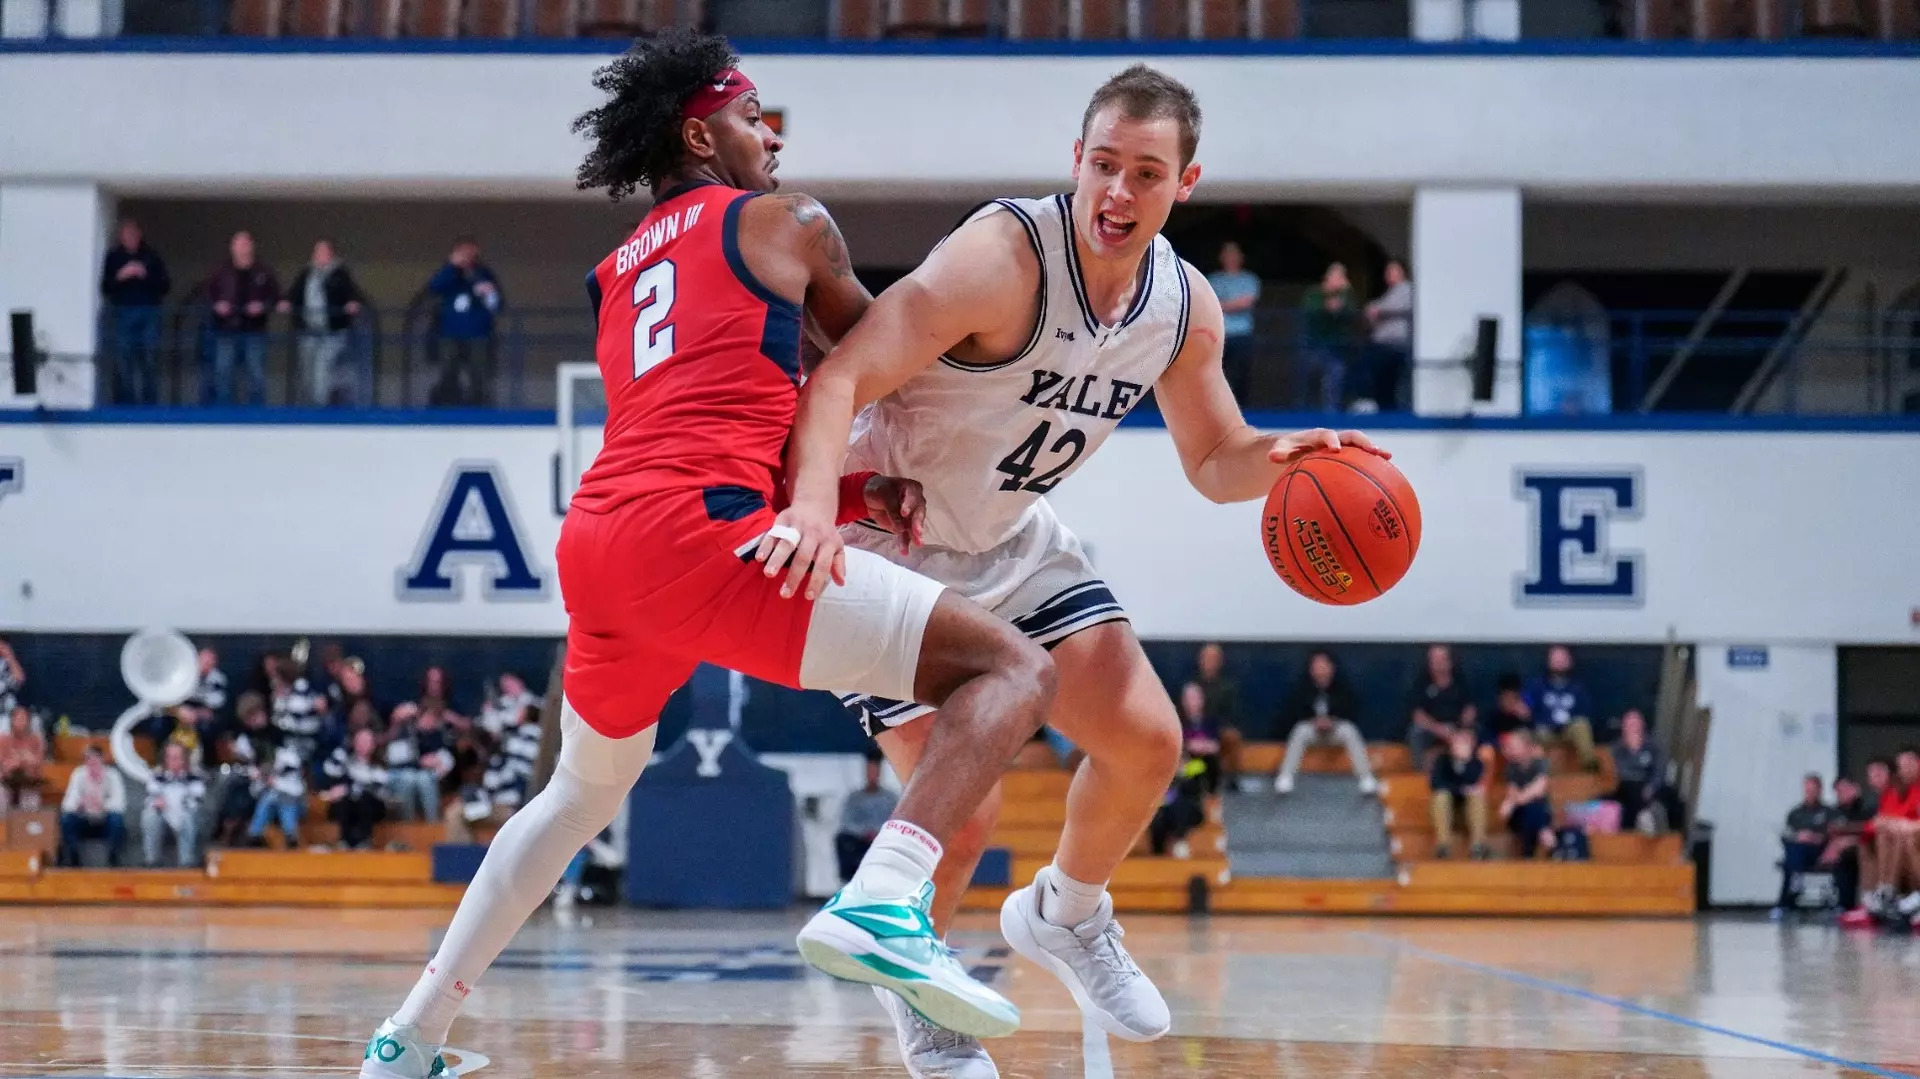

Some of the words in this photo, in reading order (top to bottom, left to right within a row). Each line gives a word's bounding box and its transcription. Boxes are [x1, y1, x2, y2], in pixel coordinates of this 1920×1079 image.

[616, 212, 680, 276] BROWN
[683, 202, 706, 233] III
[632, 258, 677, 382] 2
[1020, 369, 1142, 420] YALE
[996, 420, 1087, 494] 42
[396, 461, 551, 601] A
[1293, 517, 1348, 595] LEGACY
[1310, 520, 1341, 571] 1000
[1513, 464, 1645, 608] E
[686, 728, 734, 777] Y
